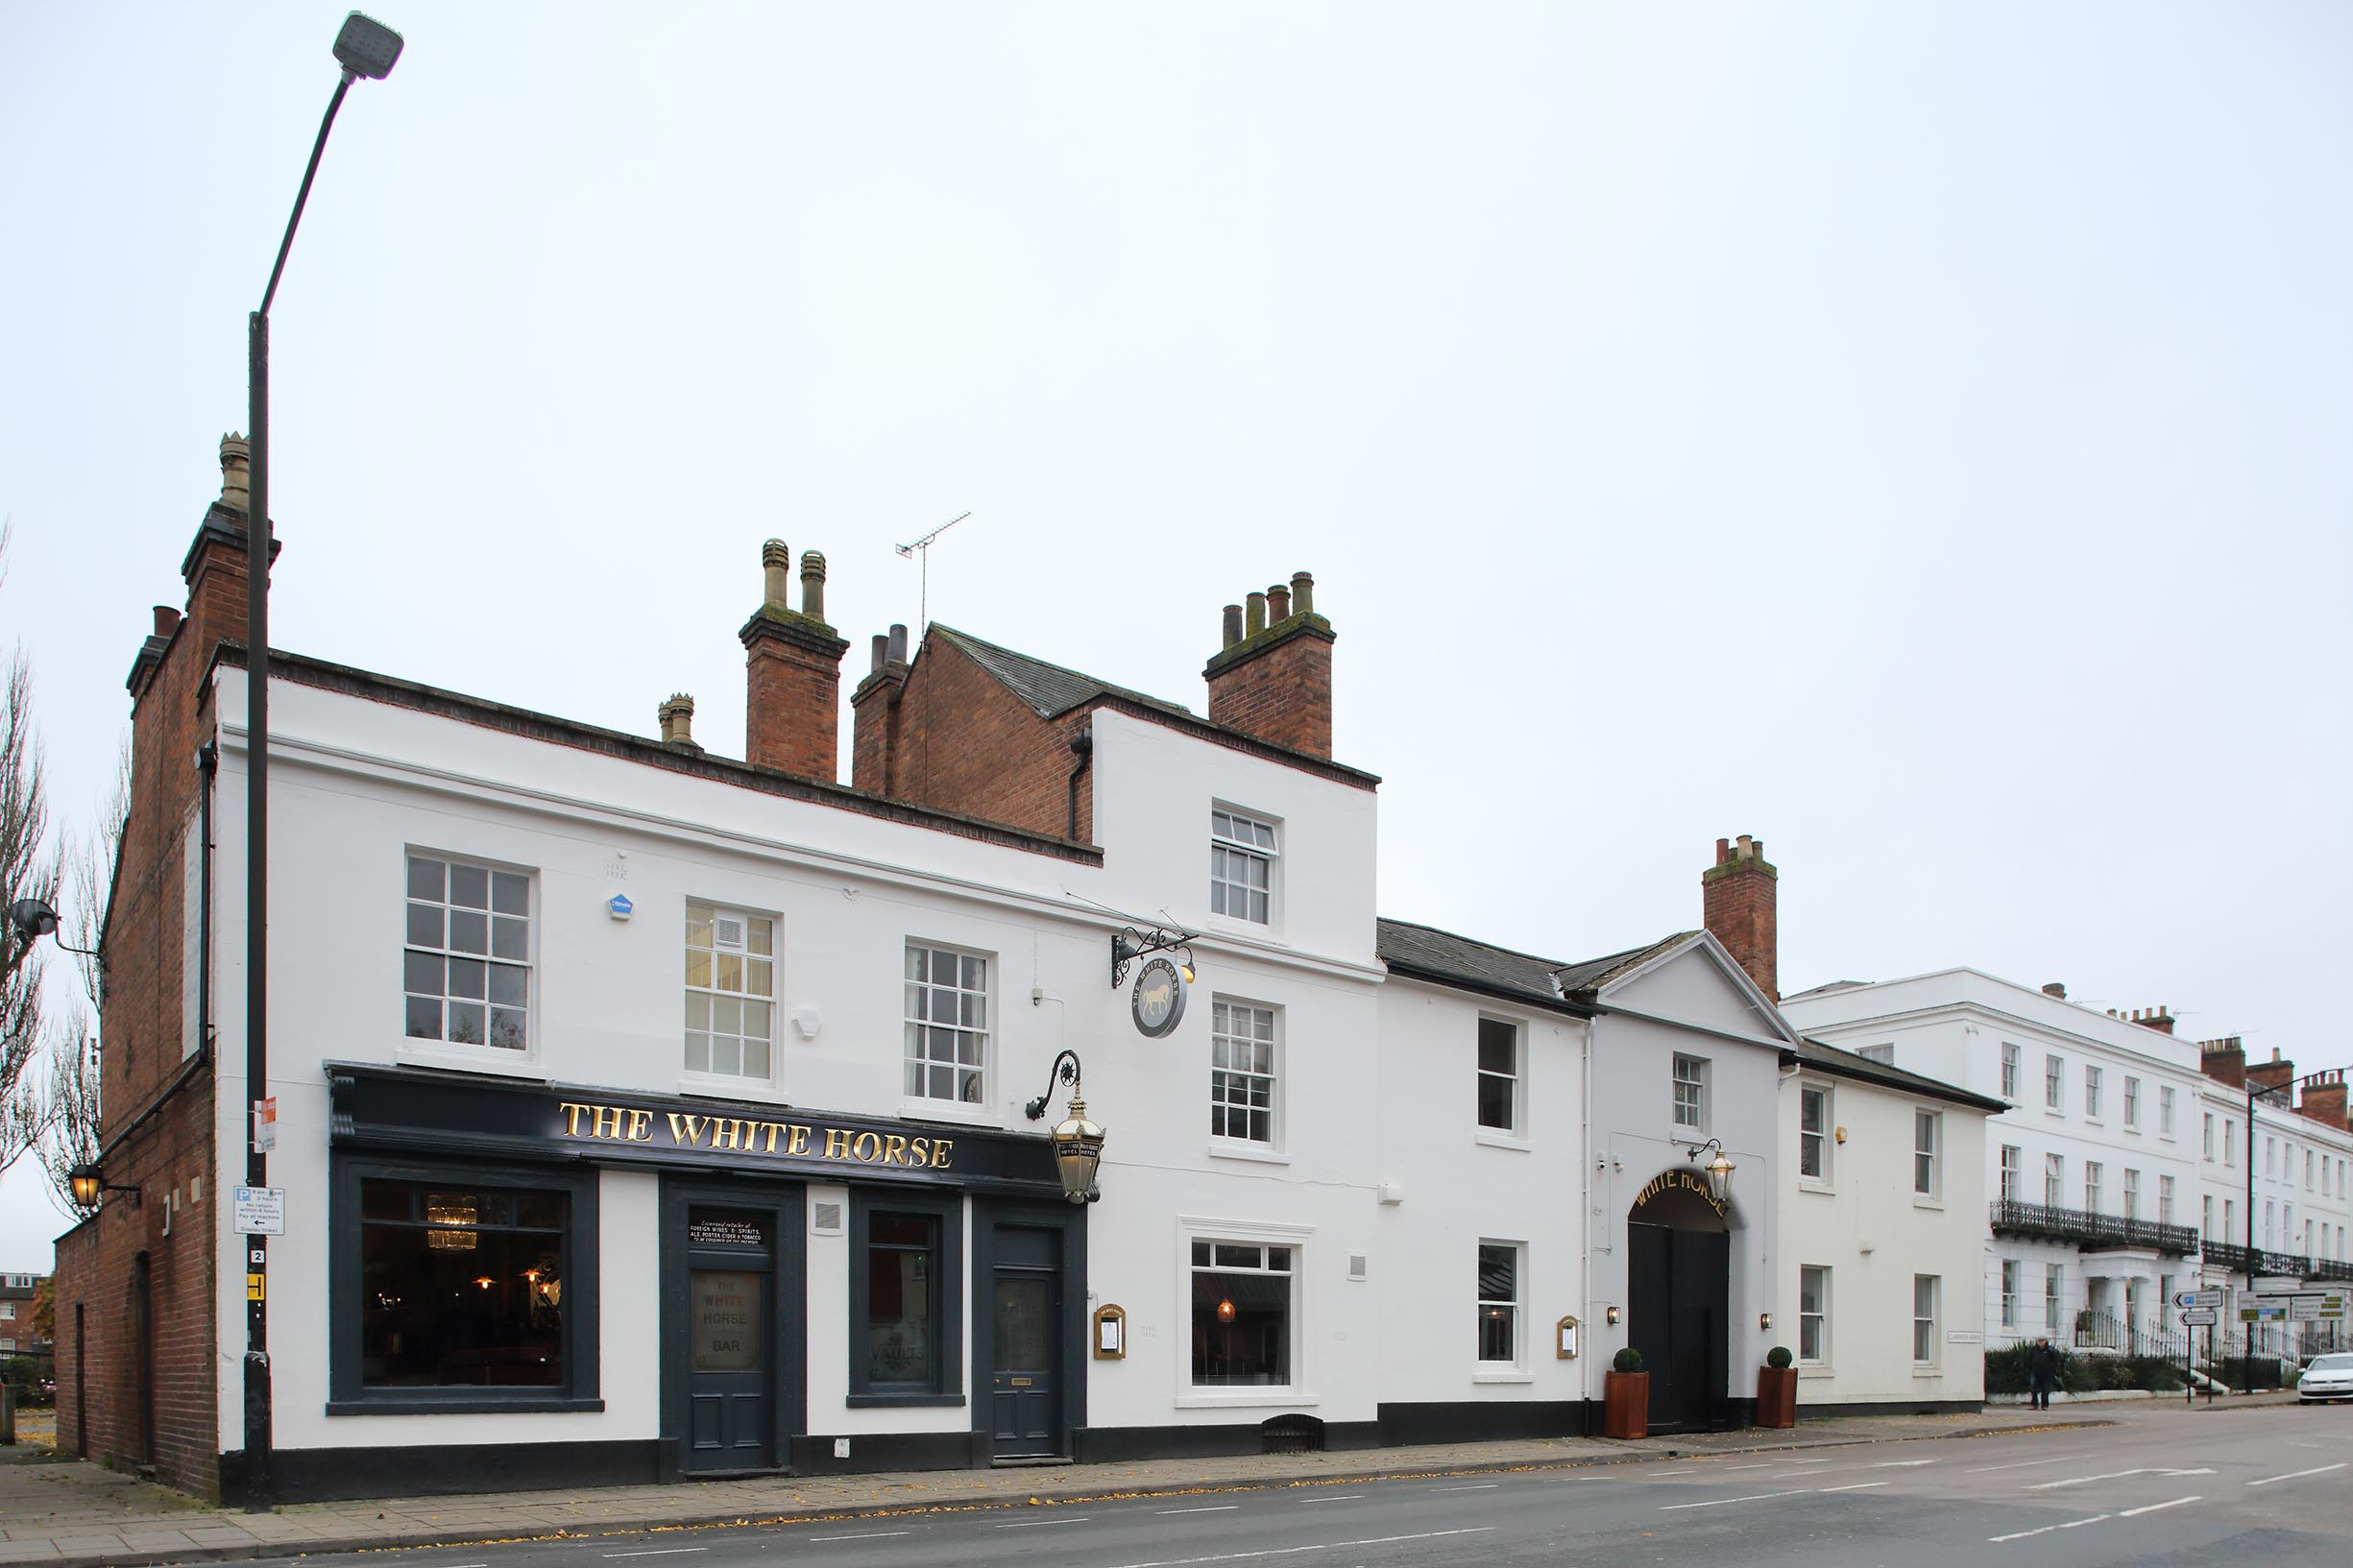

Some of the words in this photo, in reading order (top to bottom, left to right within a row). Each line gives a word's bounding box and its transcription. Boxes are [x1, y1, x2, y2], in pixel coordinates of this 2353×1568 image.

[1140, 960, 1163, 979] WHITE
[1165, 963, 1178, 997] HORSE
[559, 1102, 654, 1143] THE
[667, 1113, 813, 1156] WHITE
[822, 1128, 954, 1169] HORSE
[1637, 1170, 1676, 1207] WHITE
[255, 1252, 261, 1261] 2
[718, 1282, 736, 1291] THE
[705, 1294, 746, 1307] WHITE
[703, 1314, 746, 1324] HORSE
[713, 1340, 740, 1352] BAR
